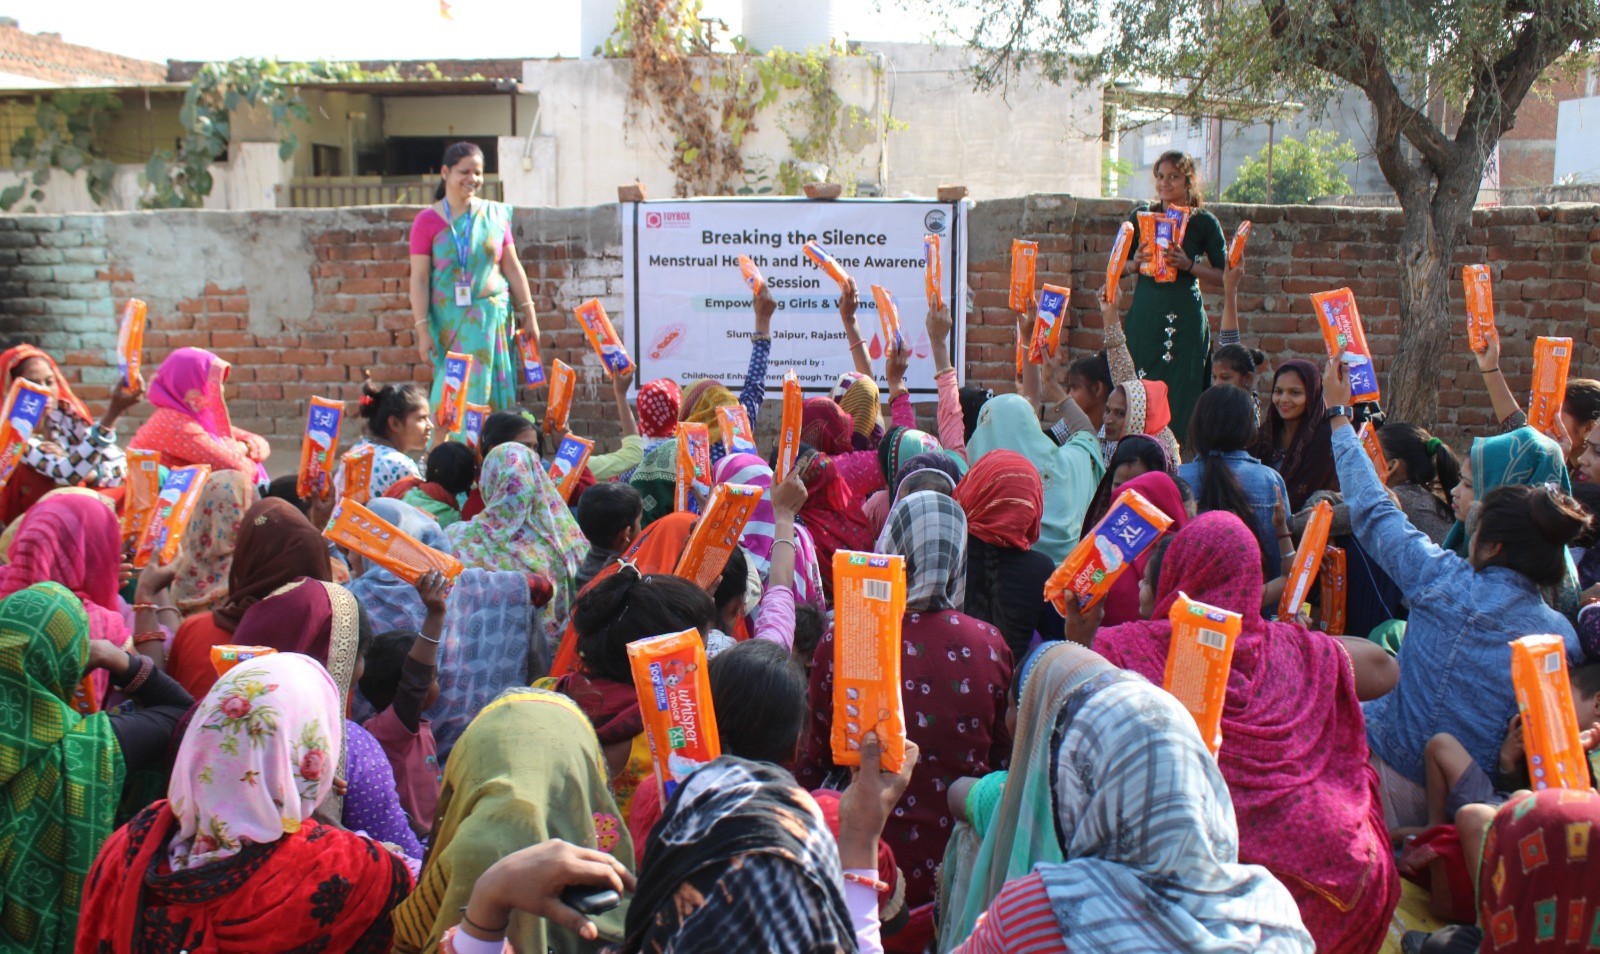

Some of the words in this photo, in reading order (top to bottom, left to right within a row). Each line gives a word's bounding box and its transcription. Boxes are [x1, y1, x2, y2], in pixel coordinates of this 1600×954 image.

[664, 212, 690, 221] TOYBOX
[702, 229, 782, 248] Breaking
[787, 230, 818, 245] the
[822, 229, 887, 245] Silence
[649, 254, 718, 267] Menstrual
[722, 255, 768, 267] Helth
[772, 255, 798, 267] and
[803, 255, 860, 269] Hyene
[863, 257, 926, 268] Awarene
[767, 275, 820, 288] Session
[705, 298, 786, 310] Empowg
[789, 298, 818, 309] Girls
[821, 299, 830, 309] &
[773, 330, 808, 341] Jaipur,
[810, 331, 849, 341] Rajasth
[1338, 334, 1347, 345] XL
[809, 359, 820, 368] by
[681, 372, 725, 380] Childhood
[799, 374, 822, 383] rough
[1349, 372, 1362, 389] XL
[319, 411, 330, 426] XL
[565, 443, 577, 456] XL
[1119, 525, 1142, 544] XL
[850, 555, 864, 564] XL
[1091, 570, 1103, 581] XL
[668, 691, 681, 721] choice
[678, 688, 699, 746] whisper
[671, 728, 684, 745] XL
